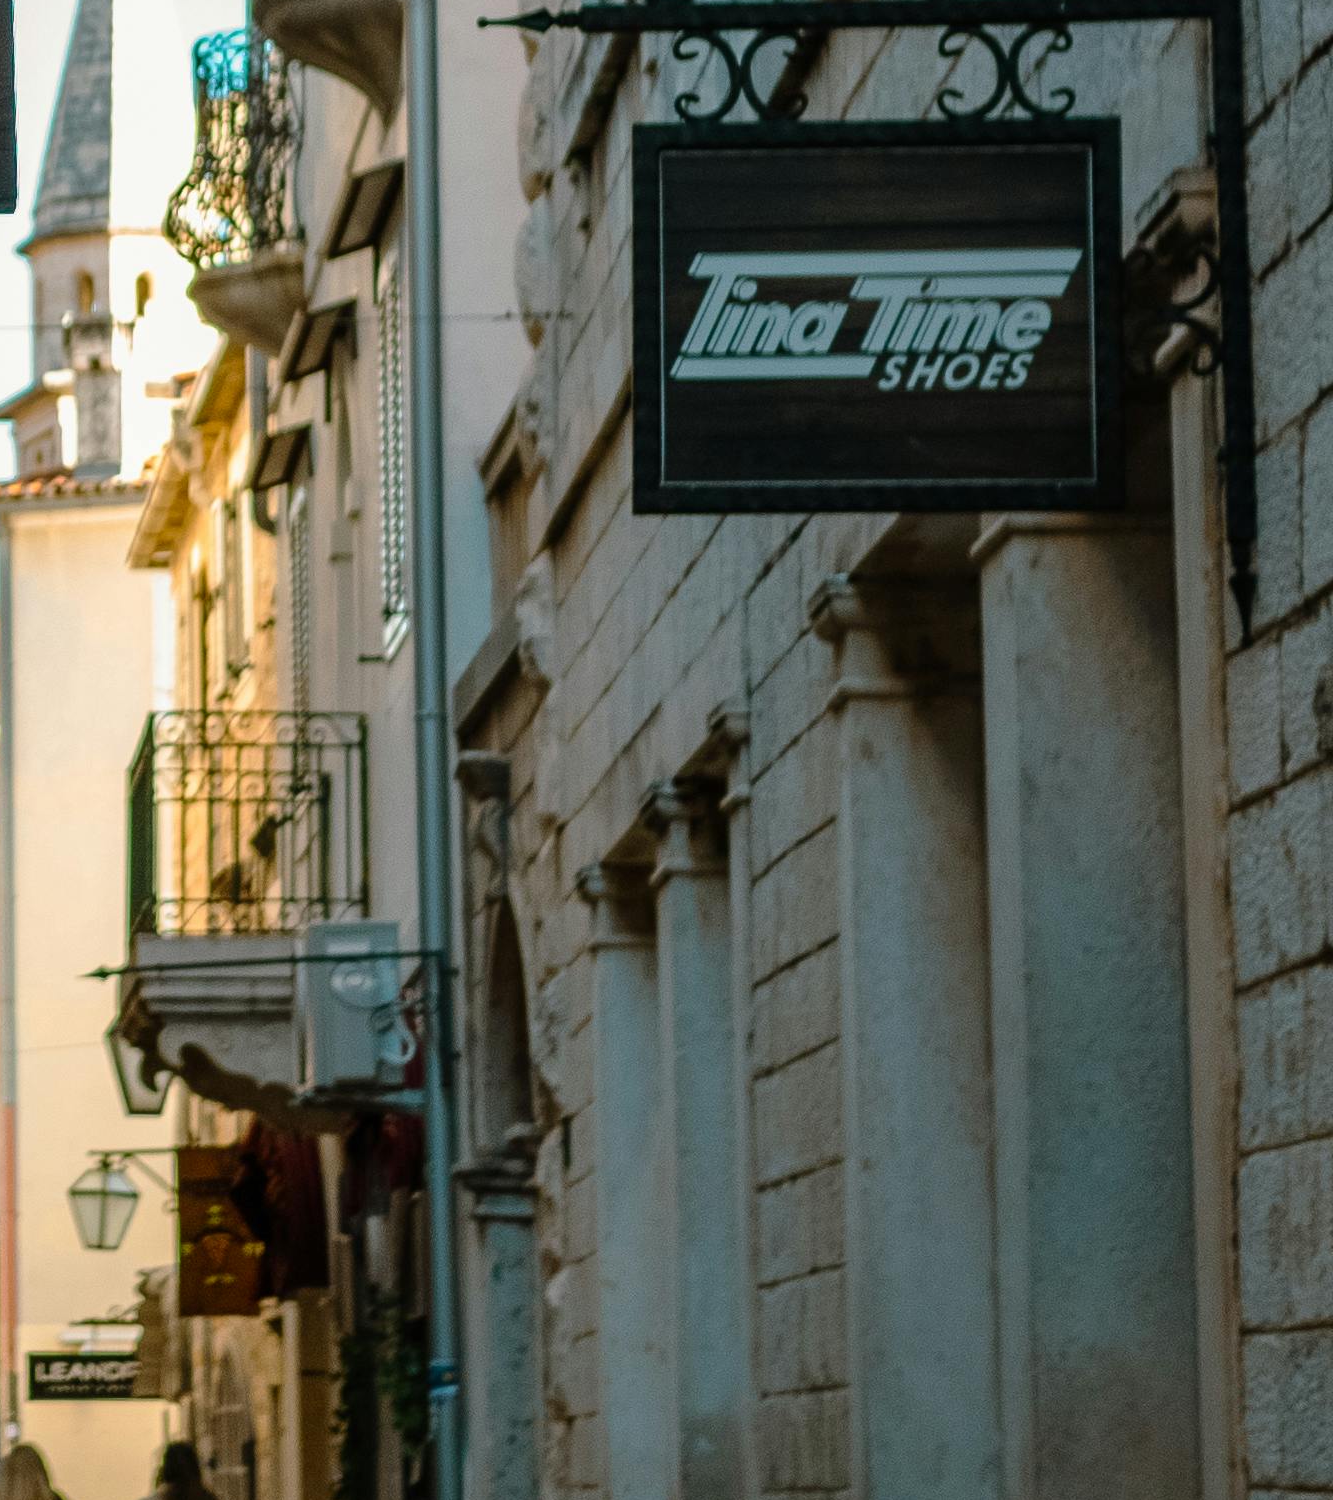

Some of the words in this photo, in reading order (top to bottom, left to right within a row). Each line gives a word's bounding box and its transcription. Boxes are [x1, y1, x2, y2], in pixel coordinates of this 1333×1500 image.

[677, 251, 851, 357] Tina
[851, 262, 1078, 355] Time
[877, 352, 1034, 392] SHOES
